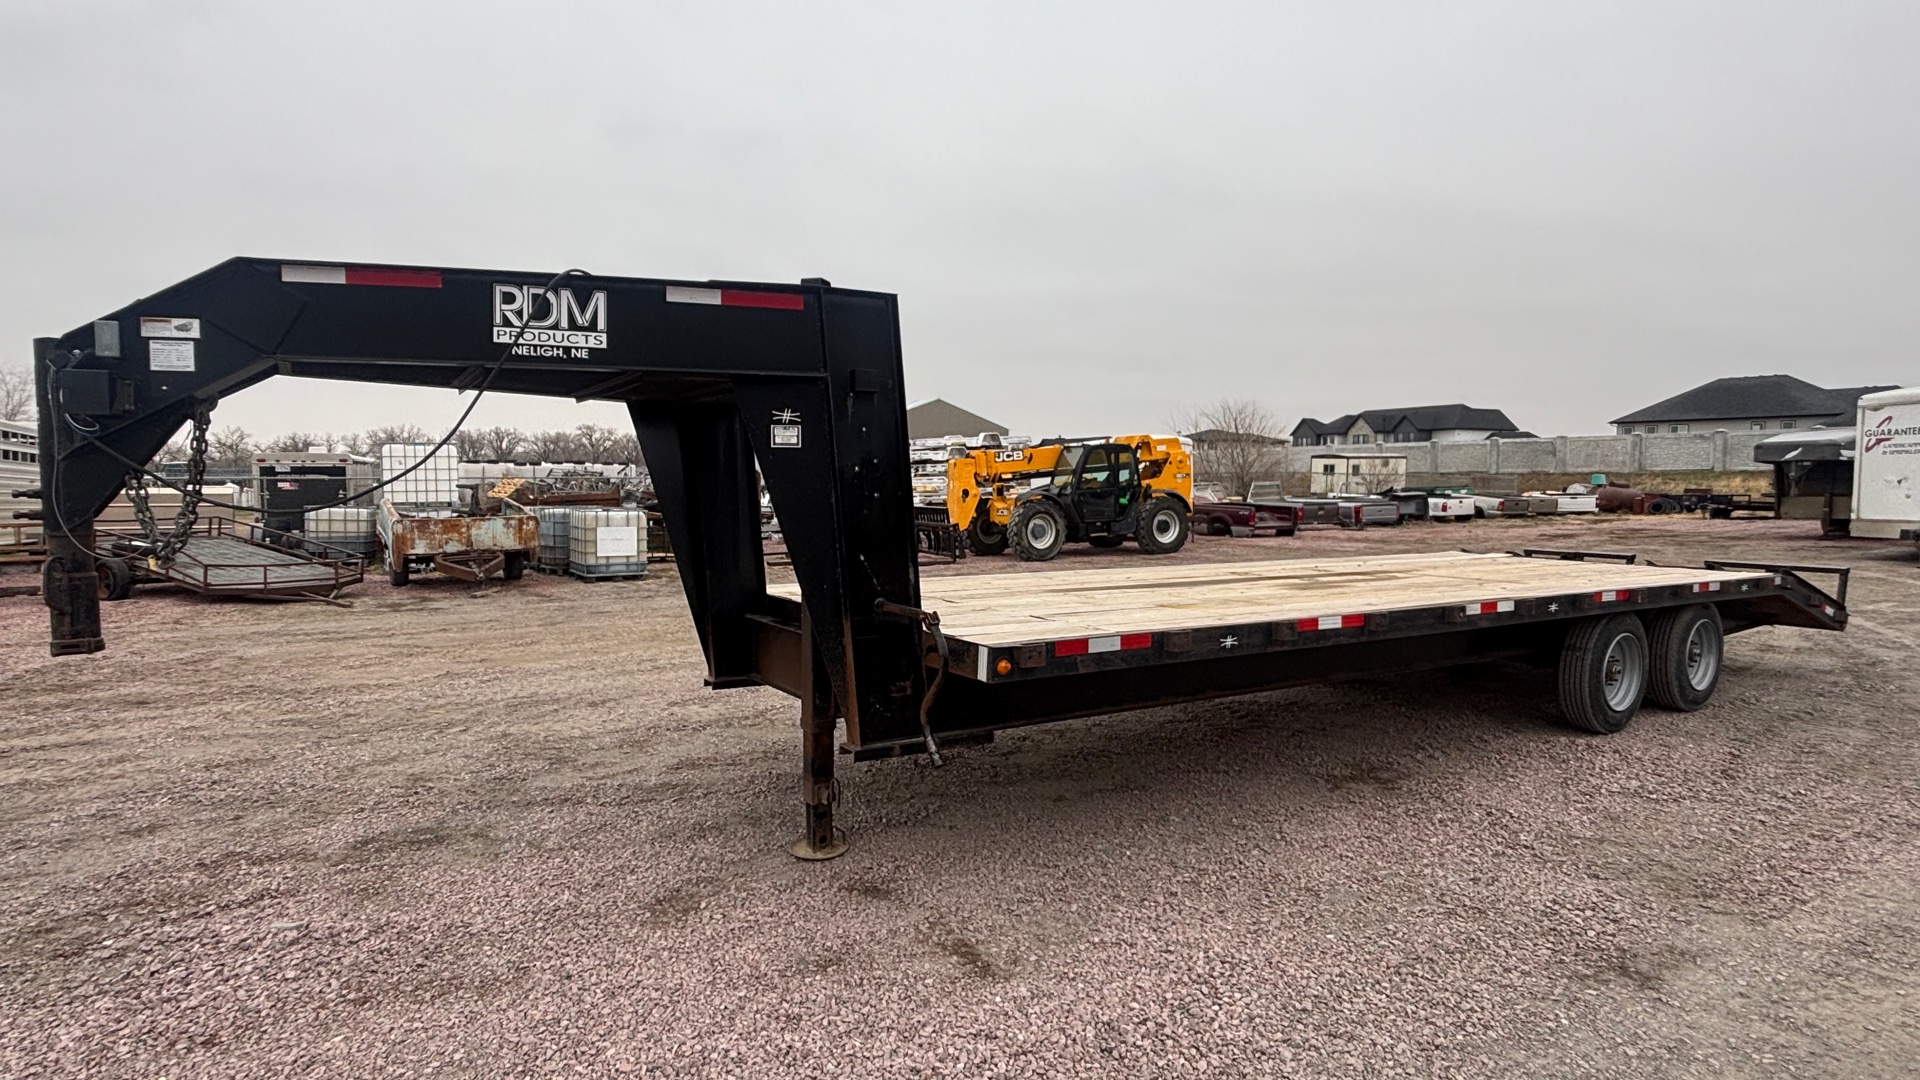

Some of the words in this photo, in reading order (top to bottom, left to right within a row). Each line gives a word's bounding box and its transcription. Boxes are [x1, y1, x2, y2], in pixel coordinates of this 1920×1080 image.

[493, 283, 607, 332] RDM
[496, 329, 603, 346] PRODUCTS
[511, 345, 567, 359] NELIGH,
[571, 348, 589, 359] NE
[995, 451, 1024, 462] JCB
